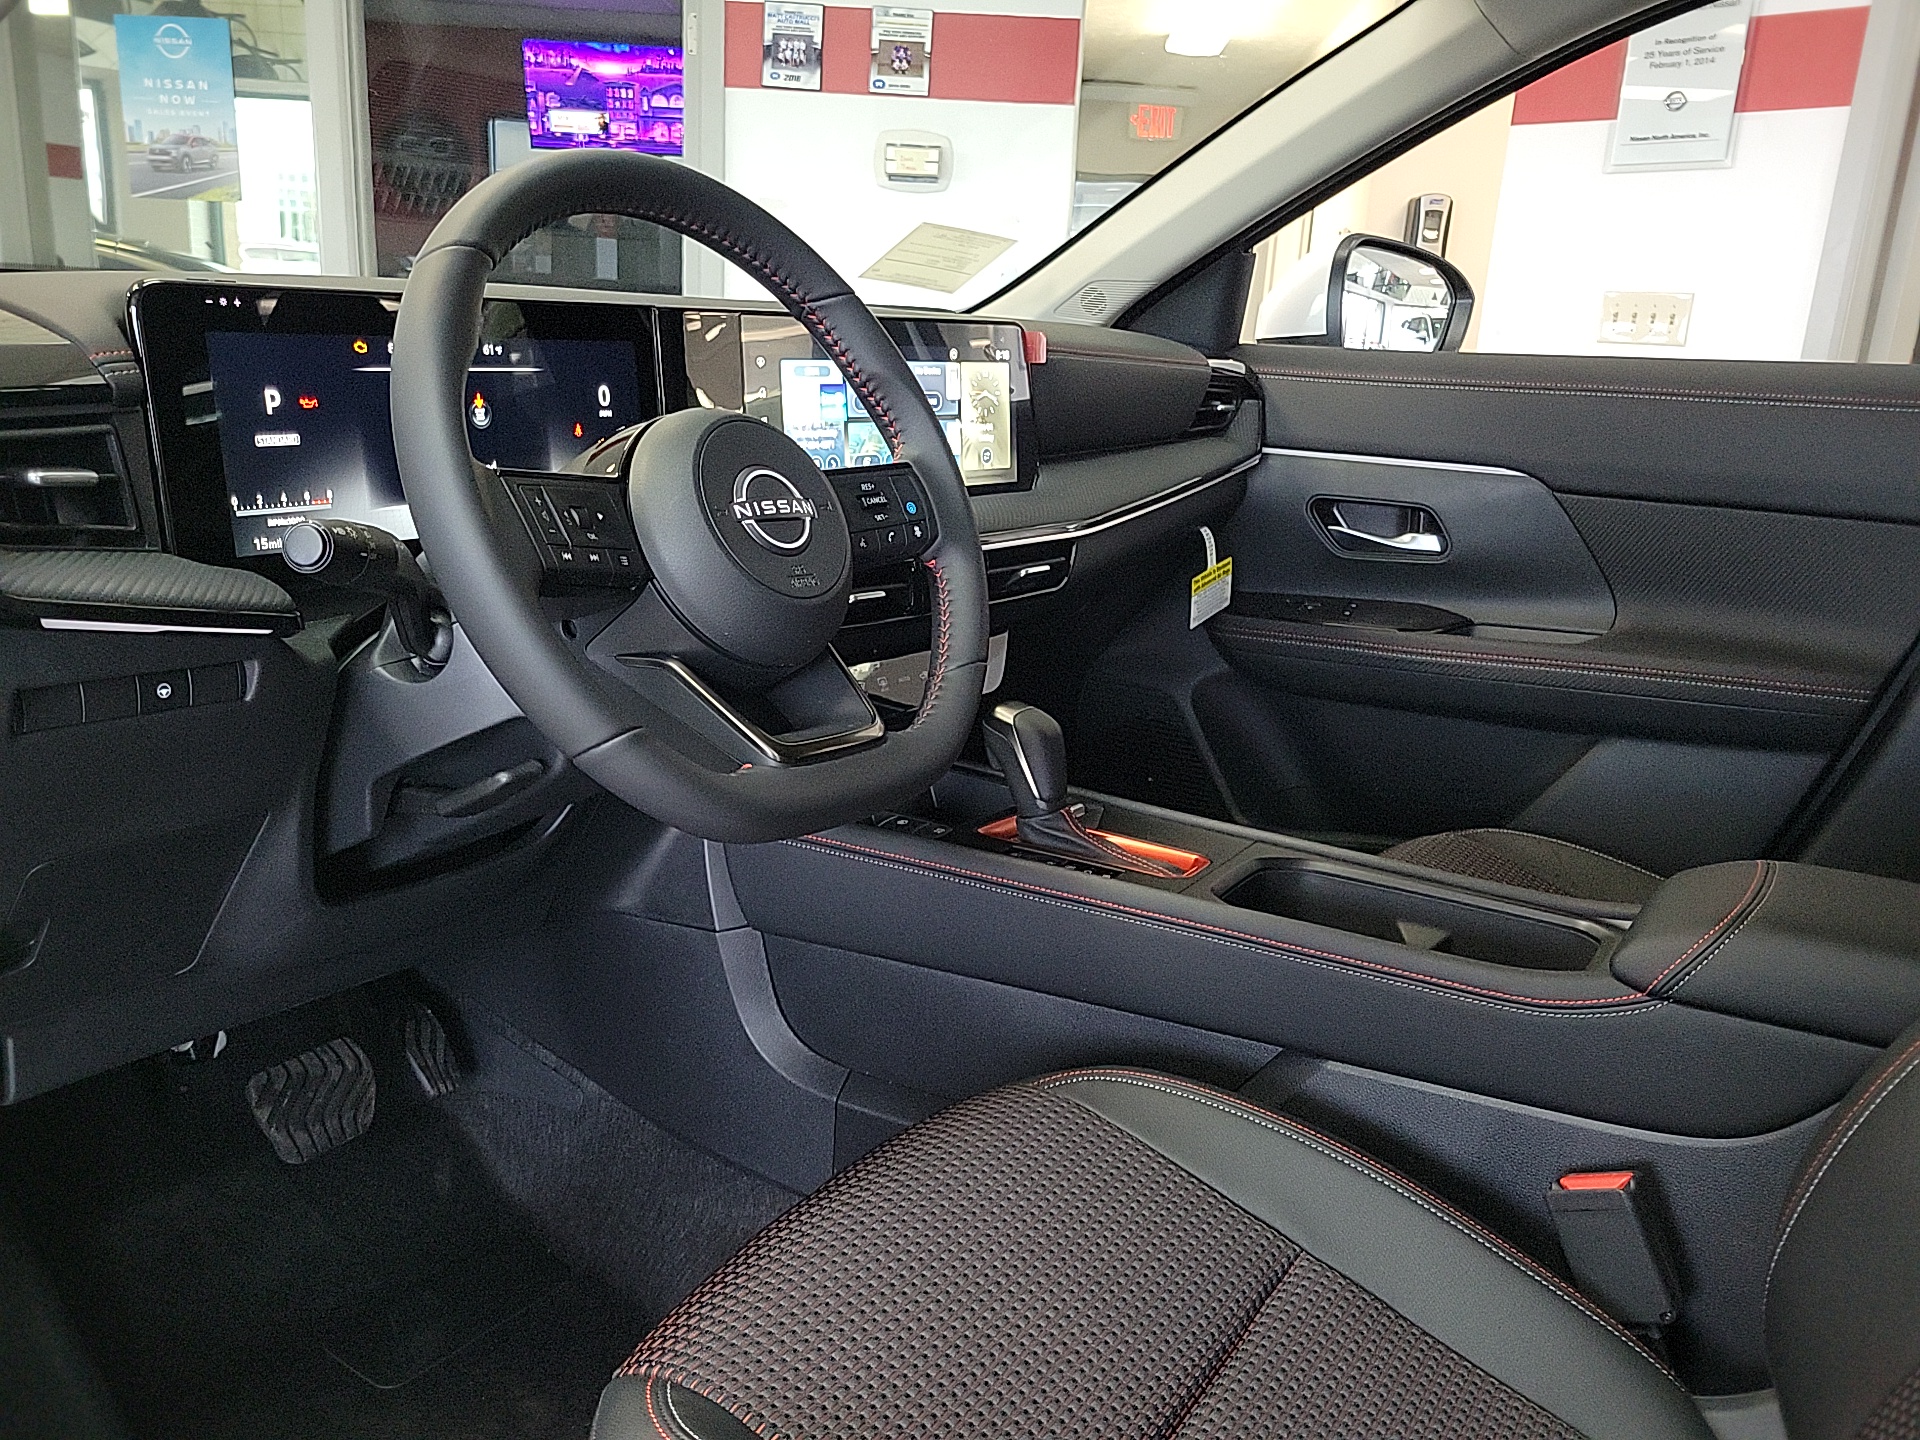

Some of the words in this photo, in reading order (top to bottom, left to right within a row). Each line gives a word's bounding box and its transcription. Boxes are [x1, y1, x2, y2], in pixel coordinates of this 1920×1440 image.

[1664, 35, 1707, 45] Recognition
[1644, 51, 1655, 60] 25
[1657, 49, 1681, 59] Years
[1682, 47, 1693, 56] of
[1693, 45, 1725, 56] Service
[1649, 60, 1682, 70] February
[1694, 56, 1717, 66] 2014
[143, 77, 209, 91] NISSAN
[159, 94, 196, 106] NOW
[1137, 104, 1177, 139] EXIT
[264, 387, 281, 415] P
[597, 384, 611, 407] 0
[866, 495, 888, 506] CANCEL
[733, 498, 815, 519] NISSAN
